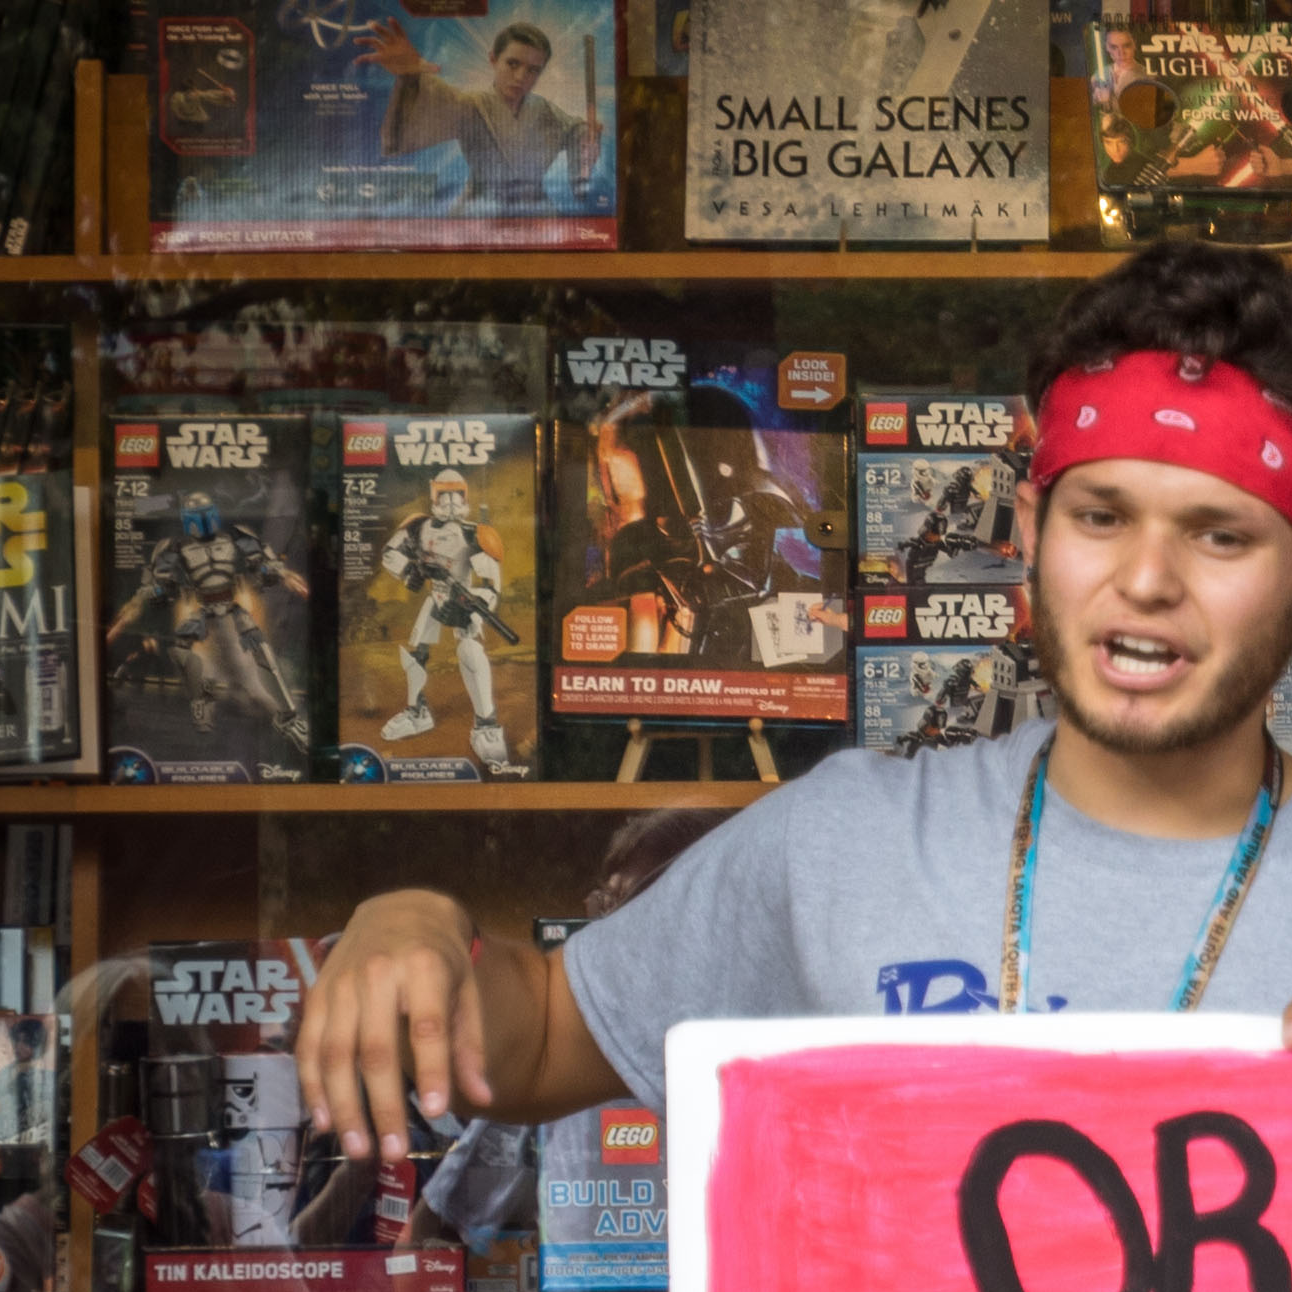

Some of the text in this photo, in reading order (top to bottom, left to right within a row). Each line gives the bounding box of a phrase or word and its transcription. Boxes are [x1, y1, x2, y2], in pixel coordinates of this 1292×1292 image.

[1141, 34, 1224, 54] STAR
[714, 95, 1031, 132] SMALL SCENES
[1182, 110, 1281, 121] FORCE WARS
[731, 139, 1029, 178] BIG GALAXY
[712, 199, 1029, 218] VESA LEHTIMÄKI
[566, 337, 687, 388] STAR WARS
[792, 359, 829, 371] LOOK
[787, 370, 835, 382] INSIDE!
[868, 402, 1015, 432] LEGO STAR
[118, 422, 269, 454] LEGO STAR
[347, 421, 496, 453] LEGO STAR
[915, 423, 1015, 447] WARS
[166, 444, 269, 469] WARS
[394, 442, 496, 467] WARS
[342, 479, 378, 496] 7-12
[864, 468, 902, 487] 6-12
[114, 481, 150, 498] 7-12
[343, 530, 361, 543] 82
[574, 615, 615, 624] FOLLOW
[868, 593, 1015, 625] LEGO STAR
[568, 624, 620, 634] THE GRIDS
[570, 633, 619, 642] TO LEARN
[914, 614, 1015, 639] WARS
[570, 641, 619, 652] TO DRAW!
[863, 662, 901, 679] 6-12
[560, 674, 626, 693] LEARN
[630, 676, 657, 693] TO
[662, 677, 724, 695] DRAW
[723, 685, 769, 696] PORTFOLIO
[770, 687, 787, 697] SET
[864, 705, 882, 718] 88
[1011, 874, 1025, 933] LAKOTA
[1195, 822, 1267, 972] YOUTH AND FAMILIES
[153, 960, 301, 993] STAR
[1006, 940, 1020, 993] YOUTH
[153, 990, 301, 1026] WARS
[604, 1125, 656, 1148] LEGO
[549, 1179, 654, 1208] BUILD
[154, 1260, 344, 1282] TIN KALEIDOSCOPE
[422, 1259, 457, 1275] Disney
